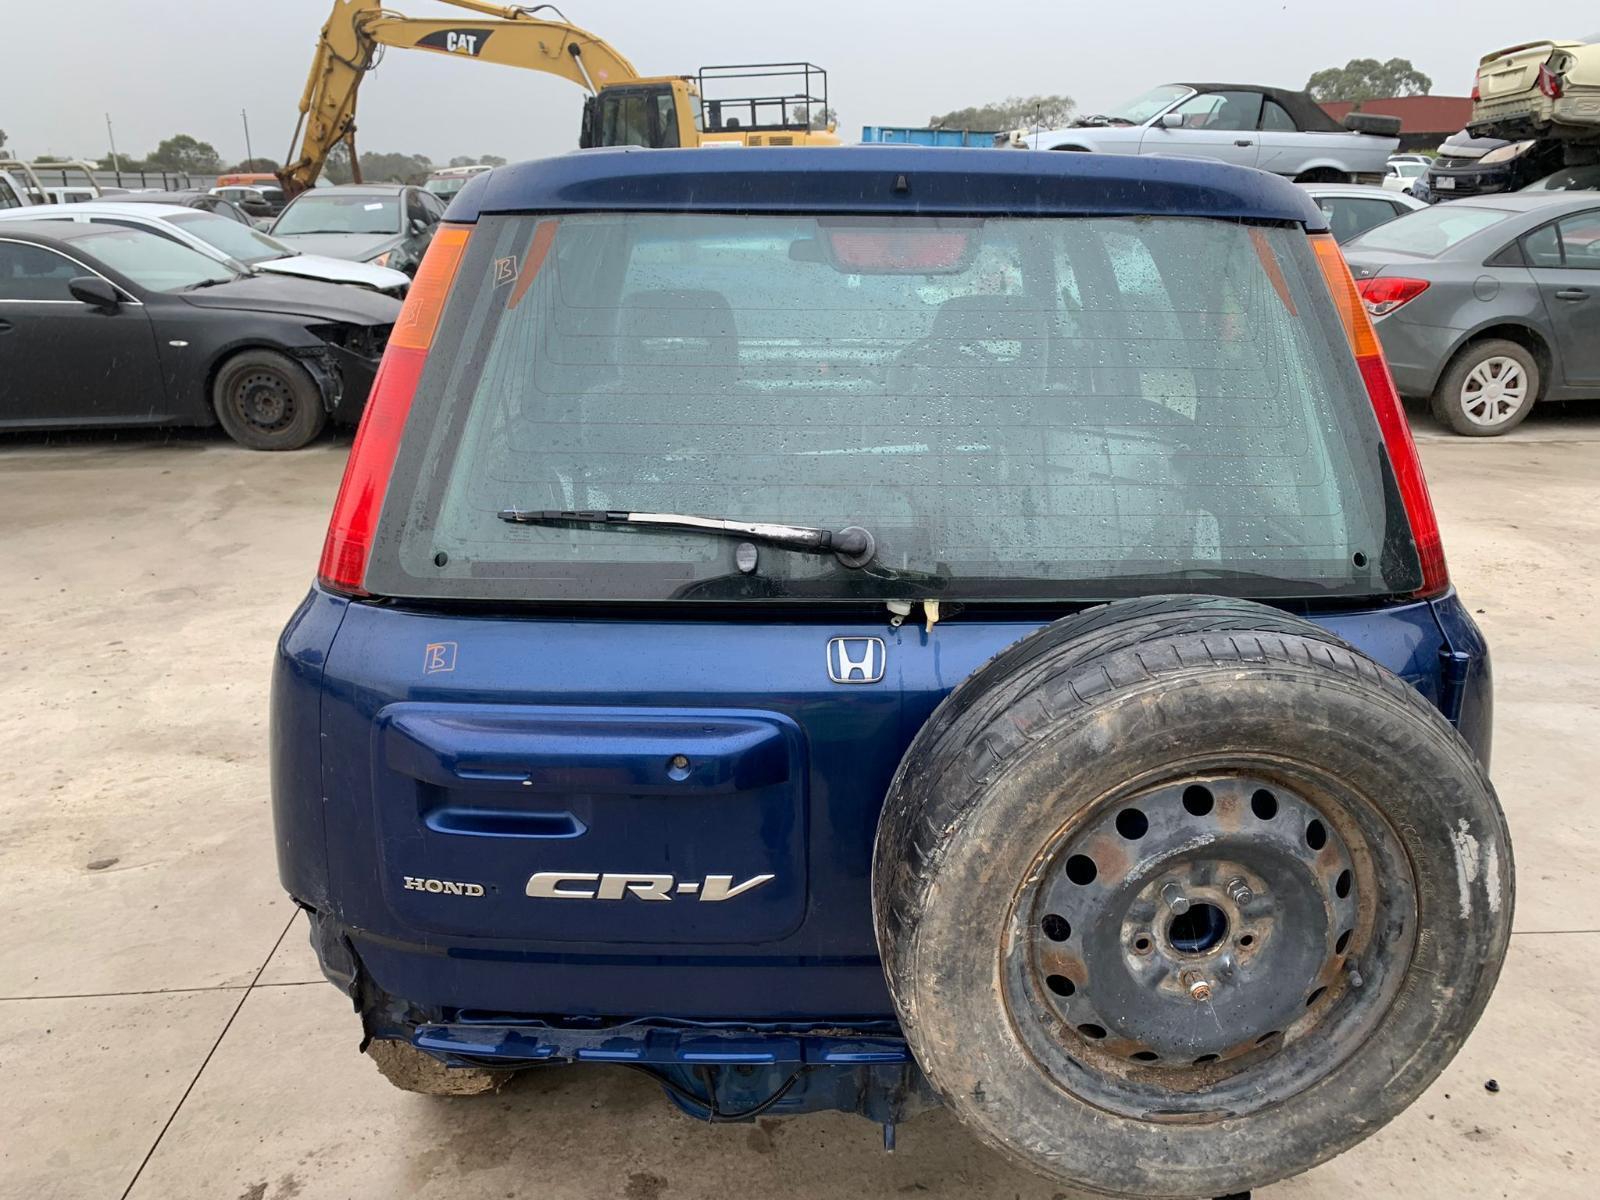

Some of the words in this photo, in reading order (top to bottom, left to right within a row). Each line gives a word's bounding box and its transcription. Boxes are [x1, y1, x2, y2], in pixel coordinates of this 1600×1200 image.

[446, 31, 477, 56] CAT
[429, 645, 446, 669] B
[403, 876, 486, 897] HOND
[525, 871, 775, 901] CR-V
